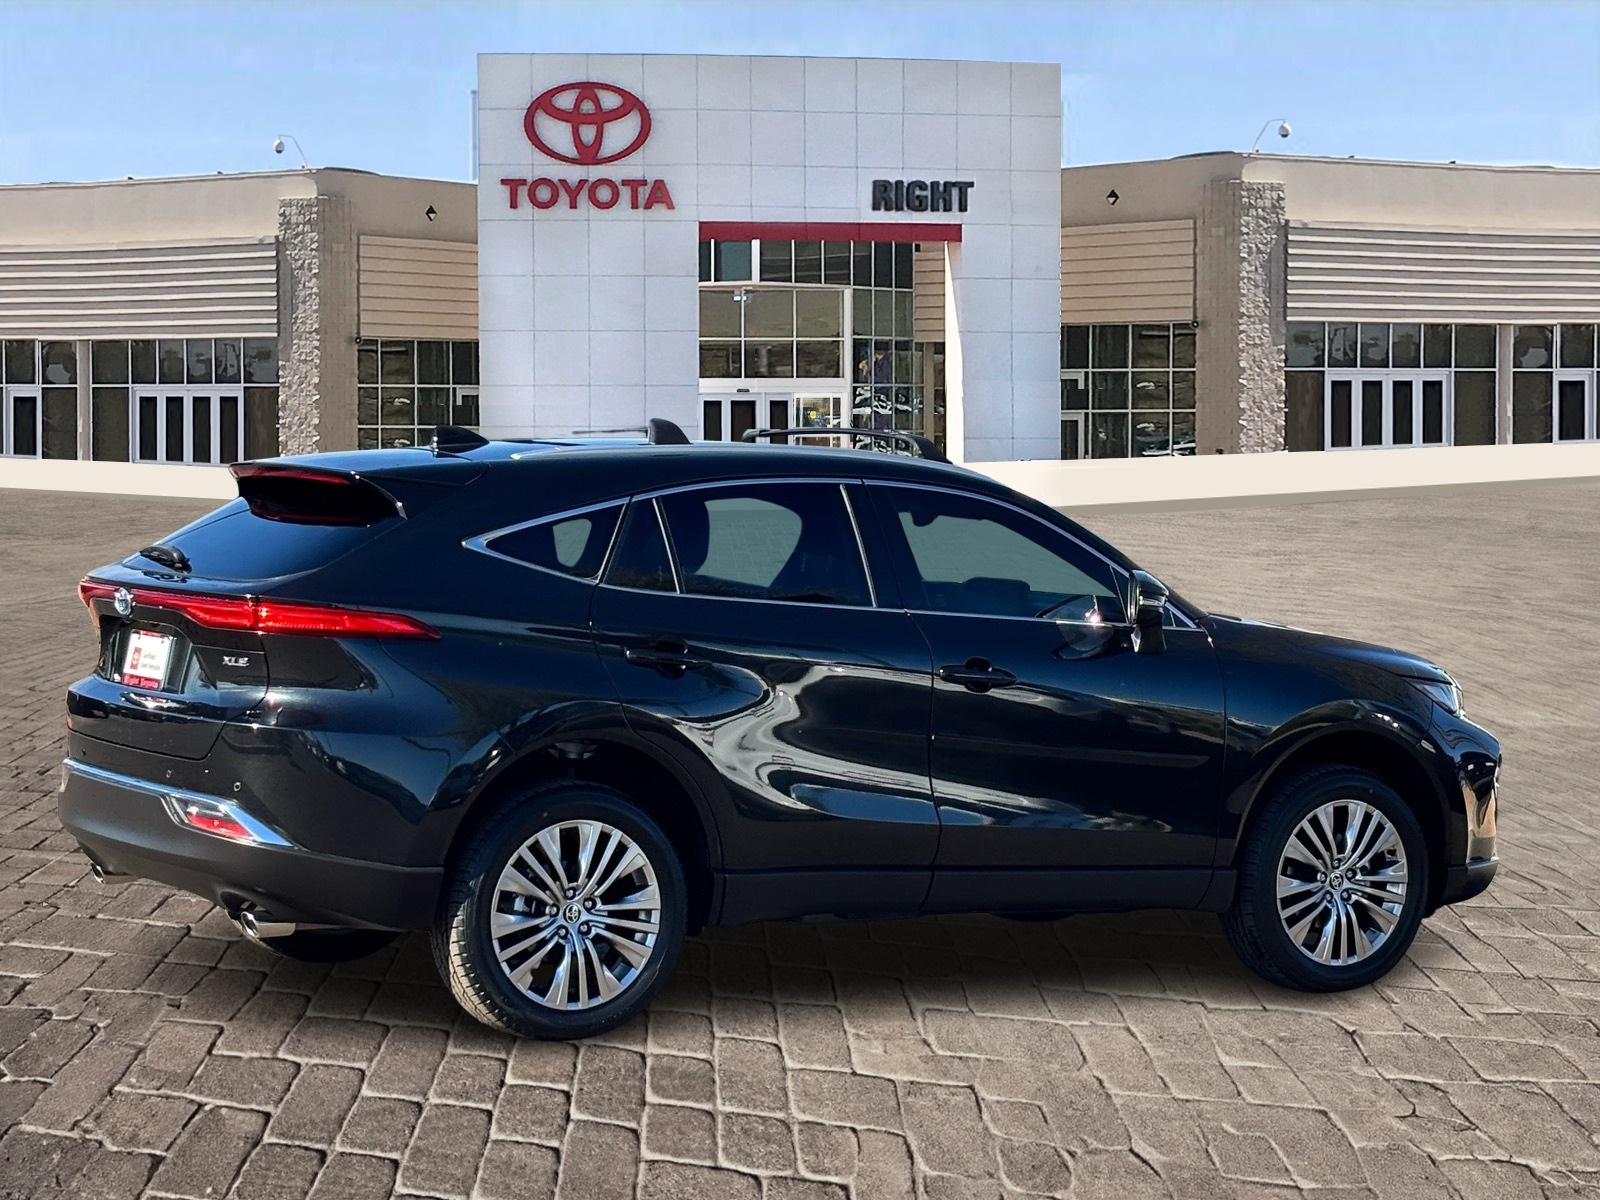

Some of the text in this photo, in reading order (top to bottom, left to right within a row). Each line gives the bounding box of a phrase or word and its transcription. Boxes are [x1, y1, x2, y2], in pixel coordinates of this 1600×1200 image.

[501, 178, 675, 210] TOYOTA
[872, 180, 975, 212] RIGHT
[222, 656, 250, 667] XLE
